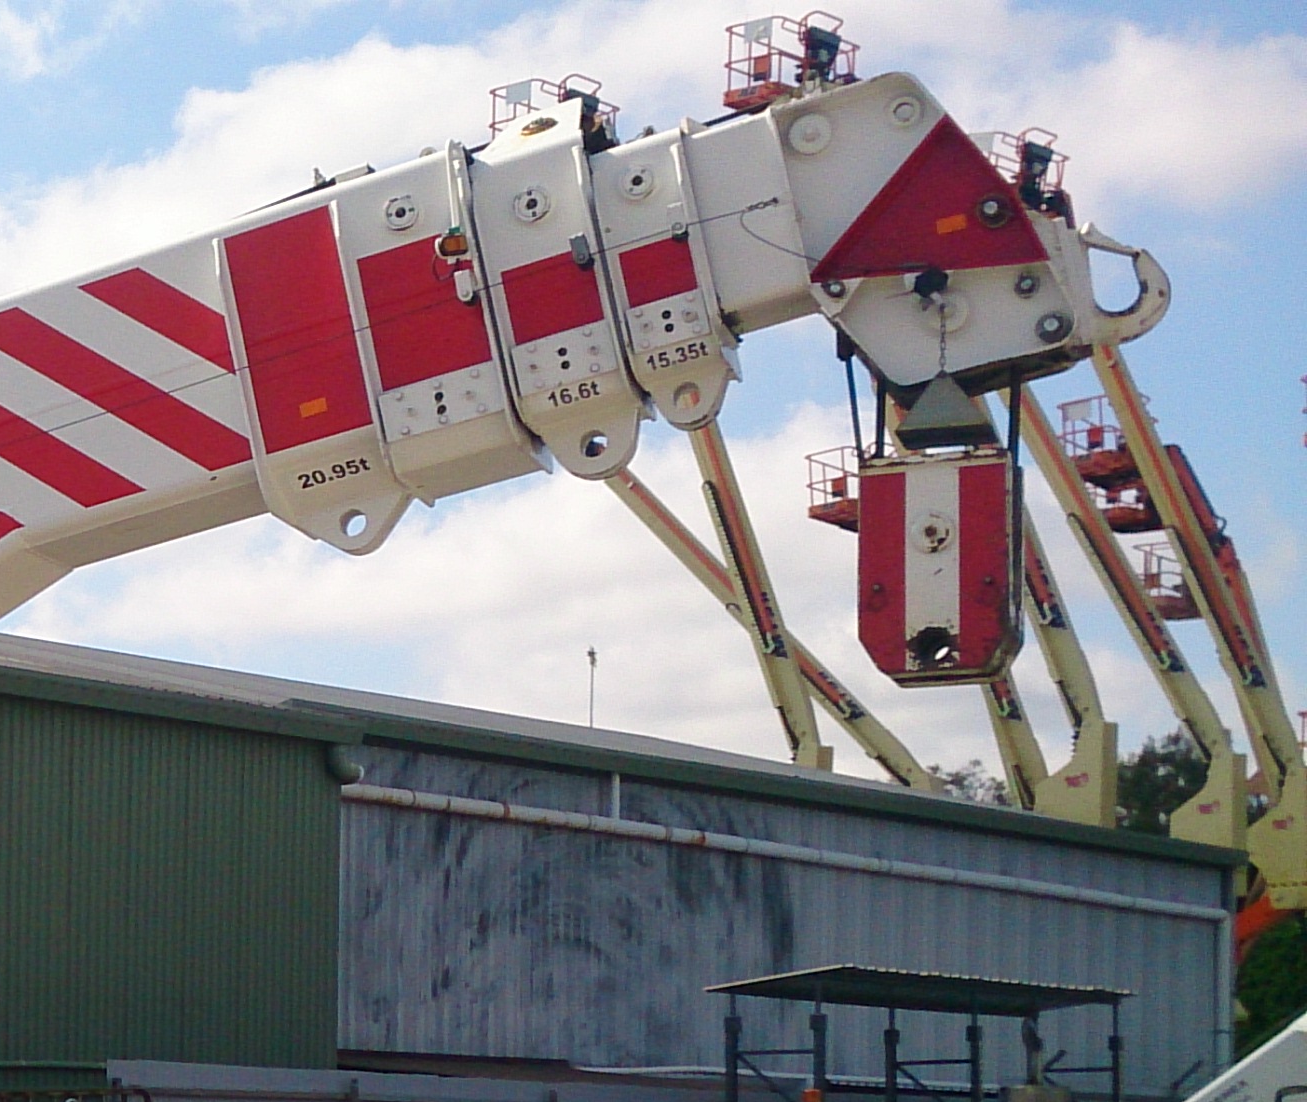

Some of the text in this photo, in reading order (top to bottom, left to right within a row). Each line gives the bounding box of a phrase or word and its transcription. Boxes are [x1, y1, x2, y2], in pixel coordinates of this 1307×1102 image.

[647, 341, 709, 371] 15.35t
[548, 381, 600, 408] 16.6t
[297, 456, 371, 489] 20.95t
